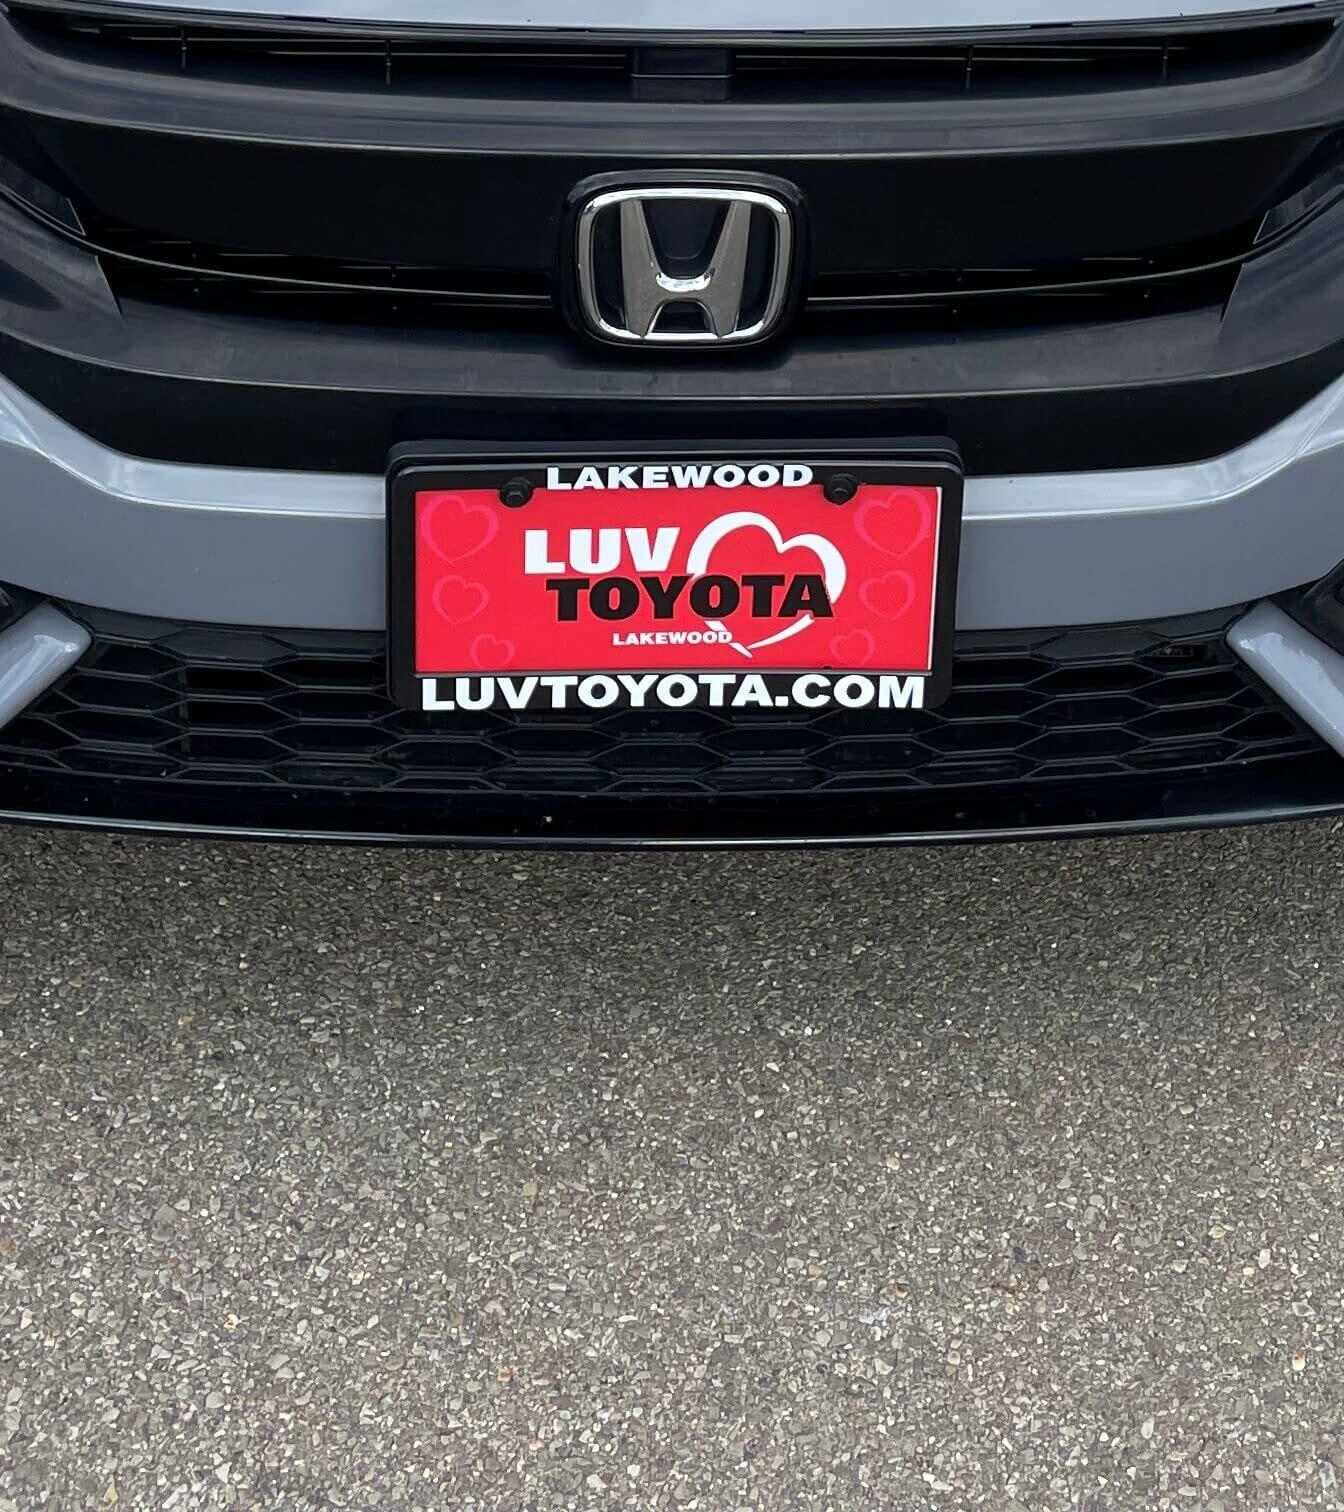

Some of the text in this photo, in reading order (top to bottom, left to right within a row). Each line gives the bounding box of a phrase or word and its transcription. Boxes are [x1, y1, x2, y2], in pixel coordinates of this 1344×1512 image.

[547, 464, 814, 491] LAKEWOOD
[524, 527, 680, 575] LUV
[546, 574, 834, 622] TOYOTA
[612, 631, 733, 646] LAKEWOOD
[422, 674, 925, 711] LUVTOYOTA.COM
